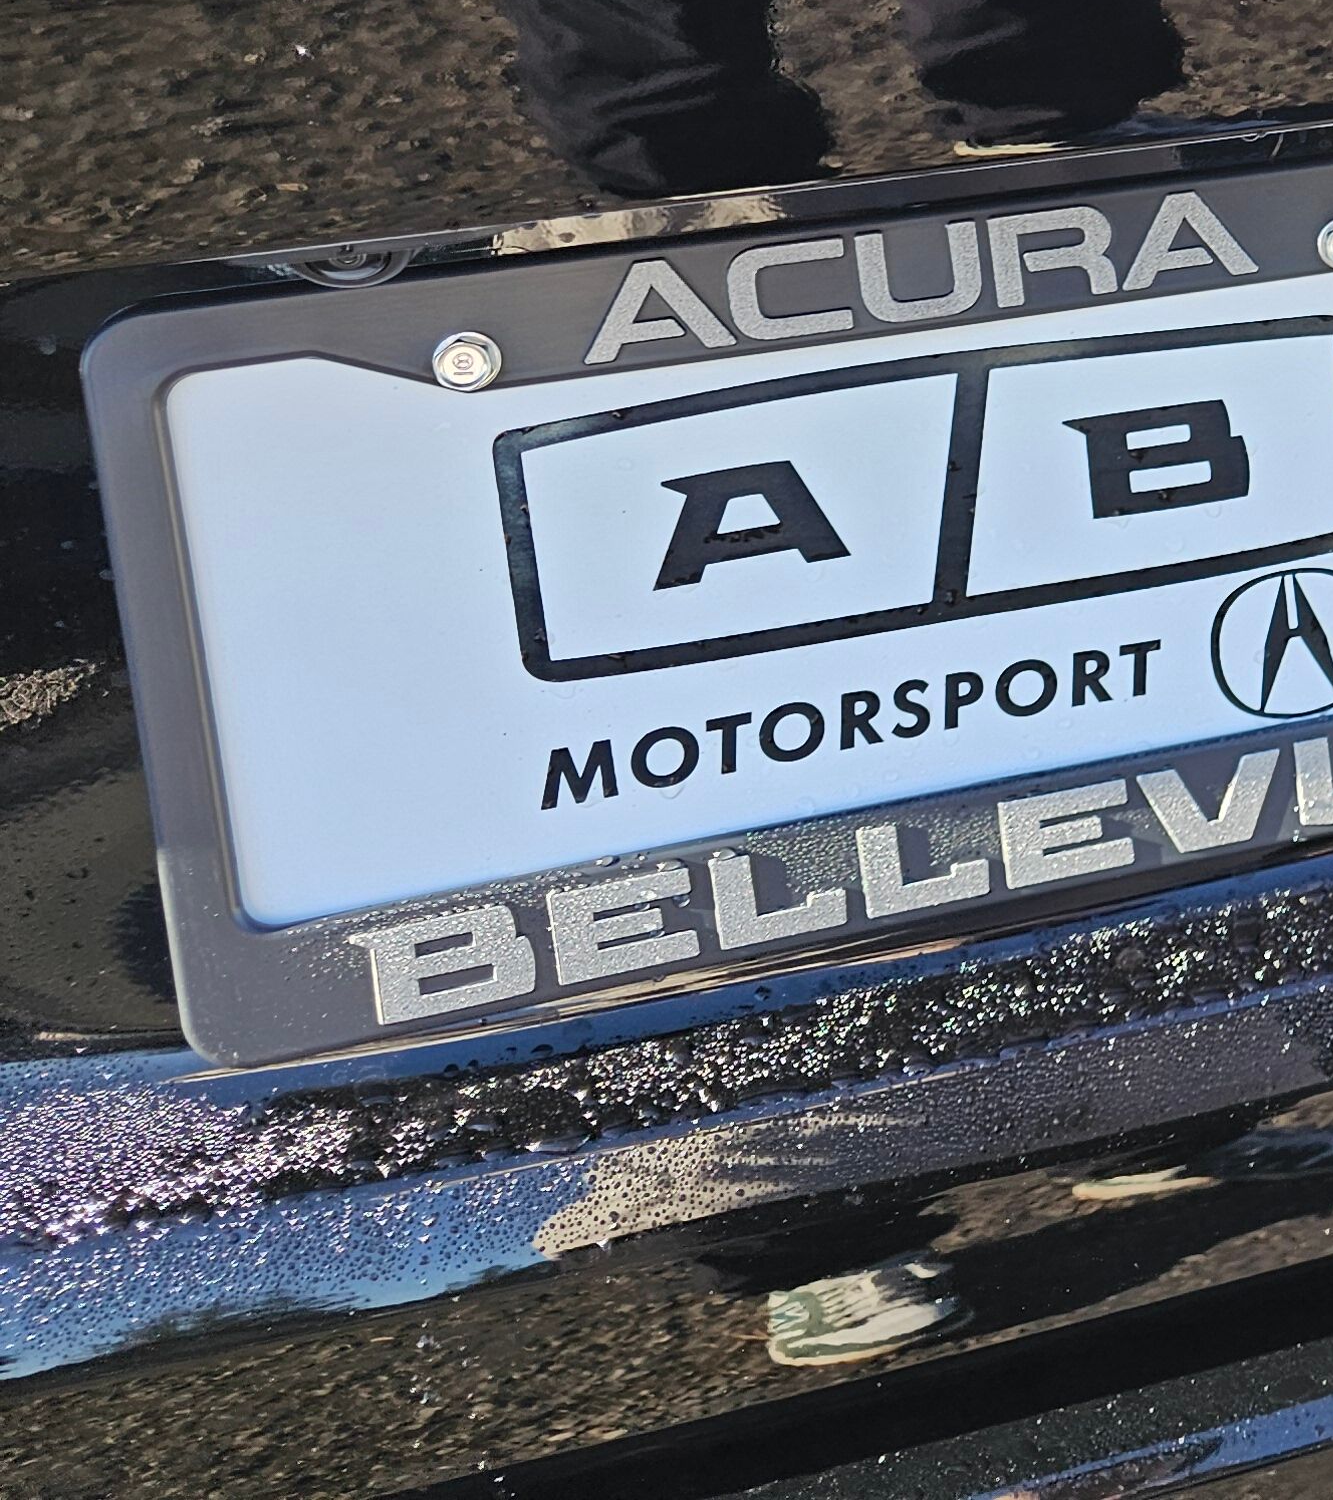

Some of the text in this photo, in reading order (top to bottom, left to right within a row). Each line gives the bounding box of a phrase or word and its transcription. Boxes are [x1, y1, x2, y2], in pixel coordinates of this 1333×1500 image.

[586, 192, 1258, 364] ACURA
[653, 399, 1250, 592] A B
[541, 639, 1164, 811] MOTORSPORT
